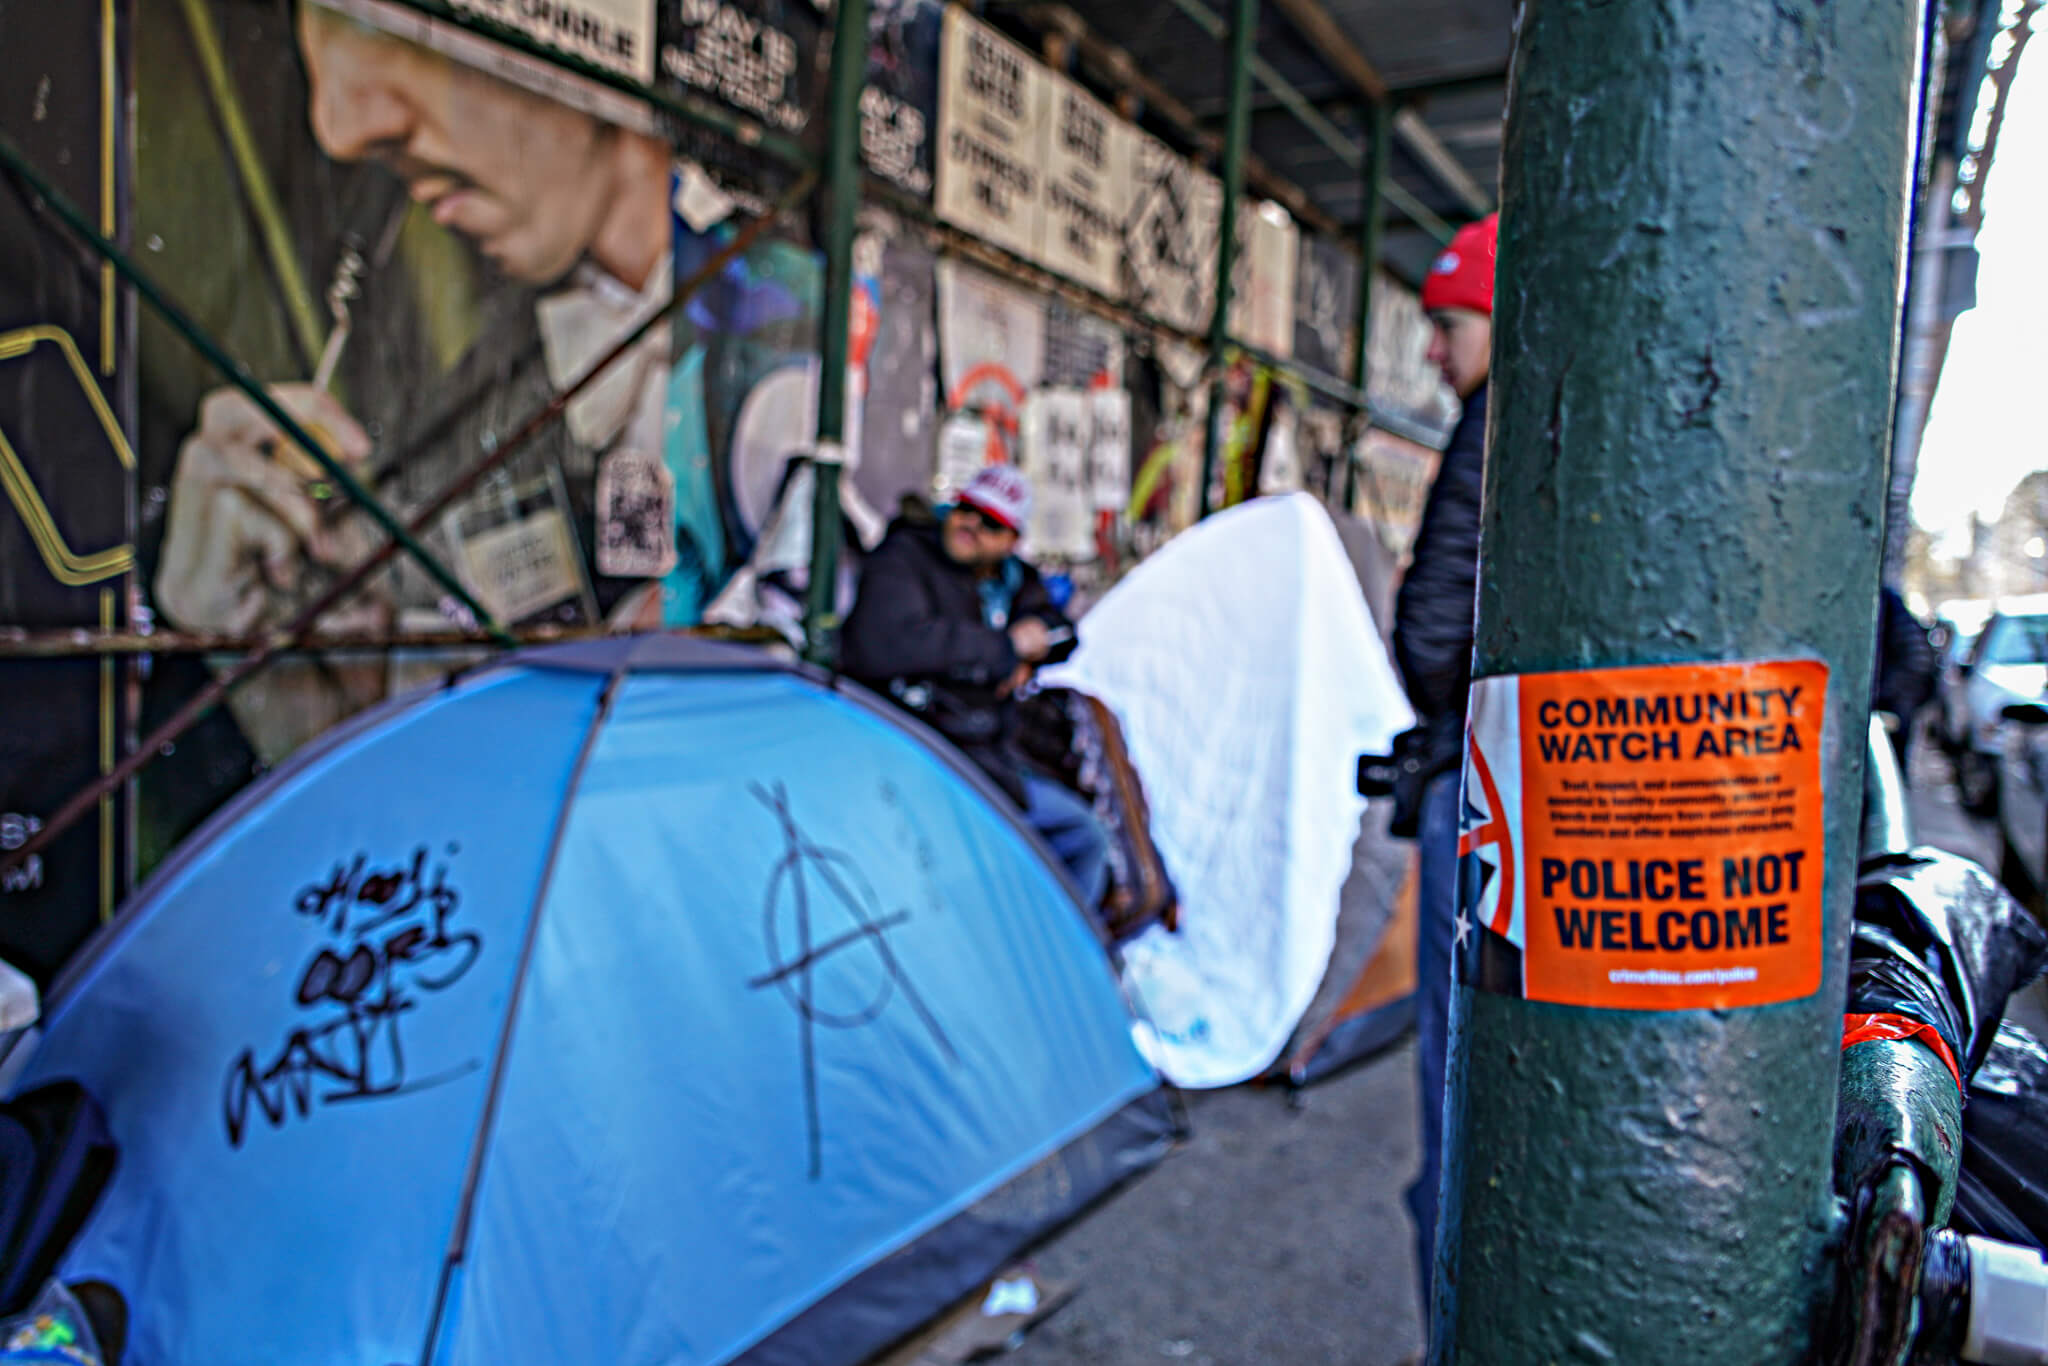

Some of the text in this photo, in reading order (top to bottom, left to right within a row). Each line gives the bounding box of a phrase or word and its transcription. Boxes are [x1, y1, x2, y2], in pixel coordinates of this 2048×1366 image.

[1538, 686, 1803, 730] COMMUNITY
[1537, 722, 1803, 764] WATCH AREA
[1540, 850, 1806, 902] POLICE NOT
[1553, 903, 1789, 953] WELCOME
